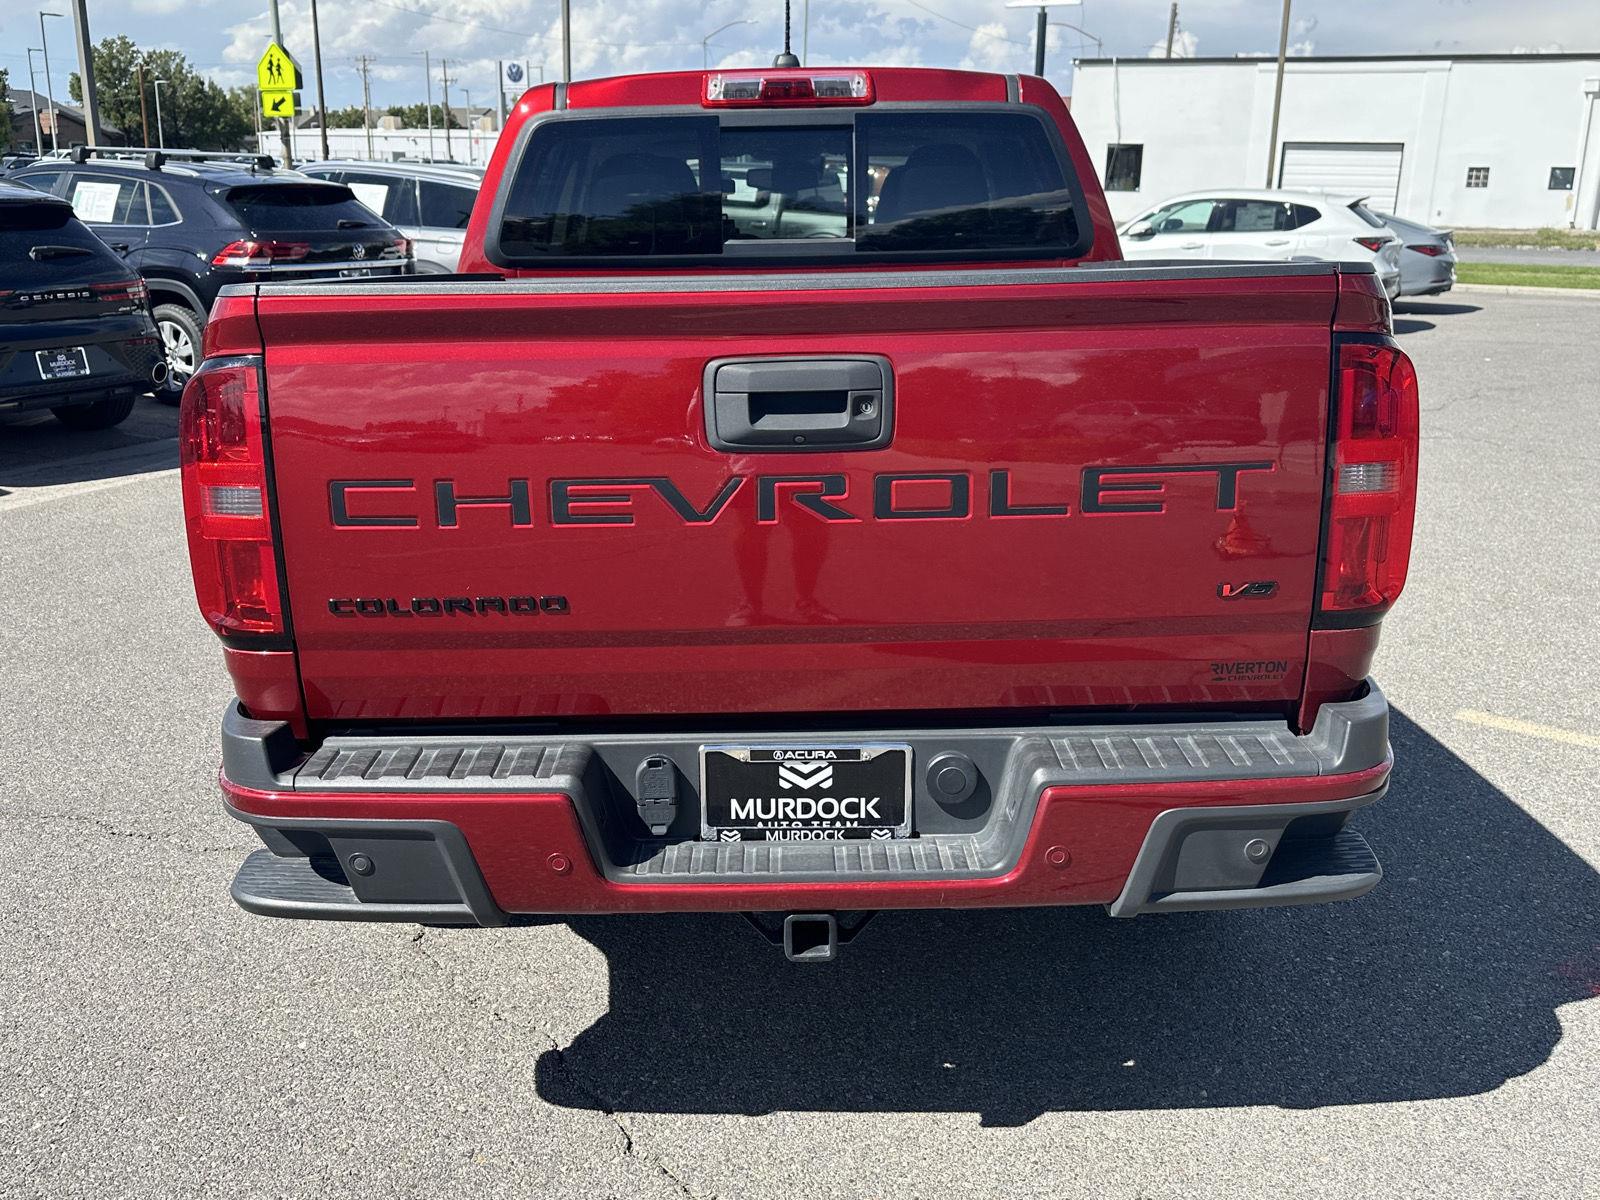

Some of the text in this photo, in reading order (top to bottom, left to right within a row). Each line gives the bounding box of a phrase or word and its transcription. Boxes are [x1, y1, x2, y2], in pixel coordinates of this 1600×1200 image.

[20, 291, 90, 301] GENESIS
[328, 461, 1276, 530] CHEVROLET
[1217, 581, 1279, 600] V6
[328, 595, 571, 617] COLORADO
[1210, 661, 1288, 675] RIVERTON
[784, 750, 837, 760] ACURA
[730, 797, 881, 820] MURDOCK
[765, 829, 845, 841] MURDOCK
